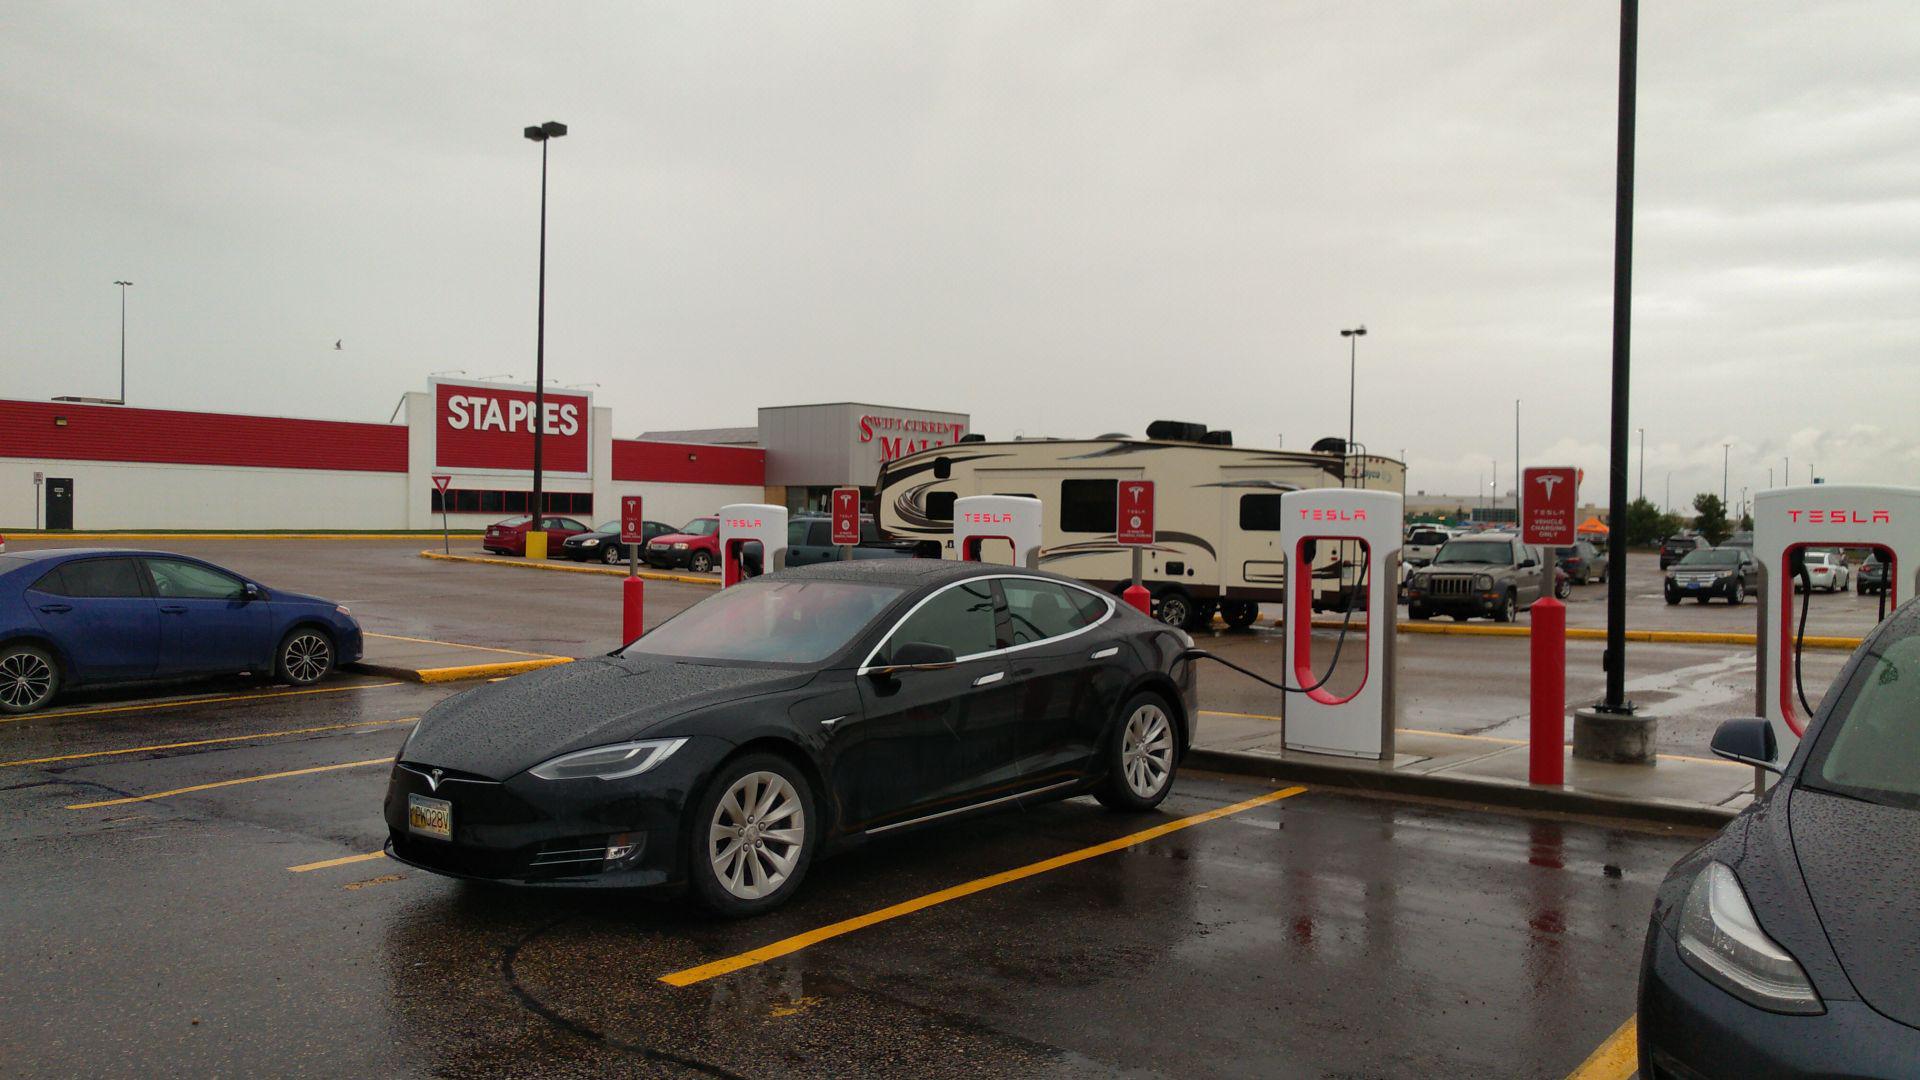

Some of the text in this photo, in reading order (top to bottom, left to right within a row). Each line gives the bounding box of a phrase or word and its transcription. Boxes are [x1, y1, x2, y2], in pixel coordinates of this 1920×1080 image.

[448, 395, 578, 436] STAPLES
[879, 436, 943, 463] MA
[964, 513, 1012, 523] TESLA
[1299, 508, 1367, 520] TESLA
[1787, 510, 1889, 523] TESLA
[726, 518, 762, 528] TESLA
